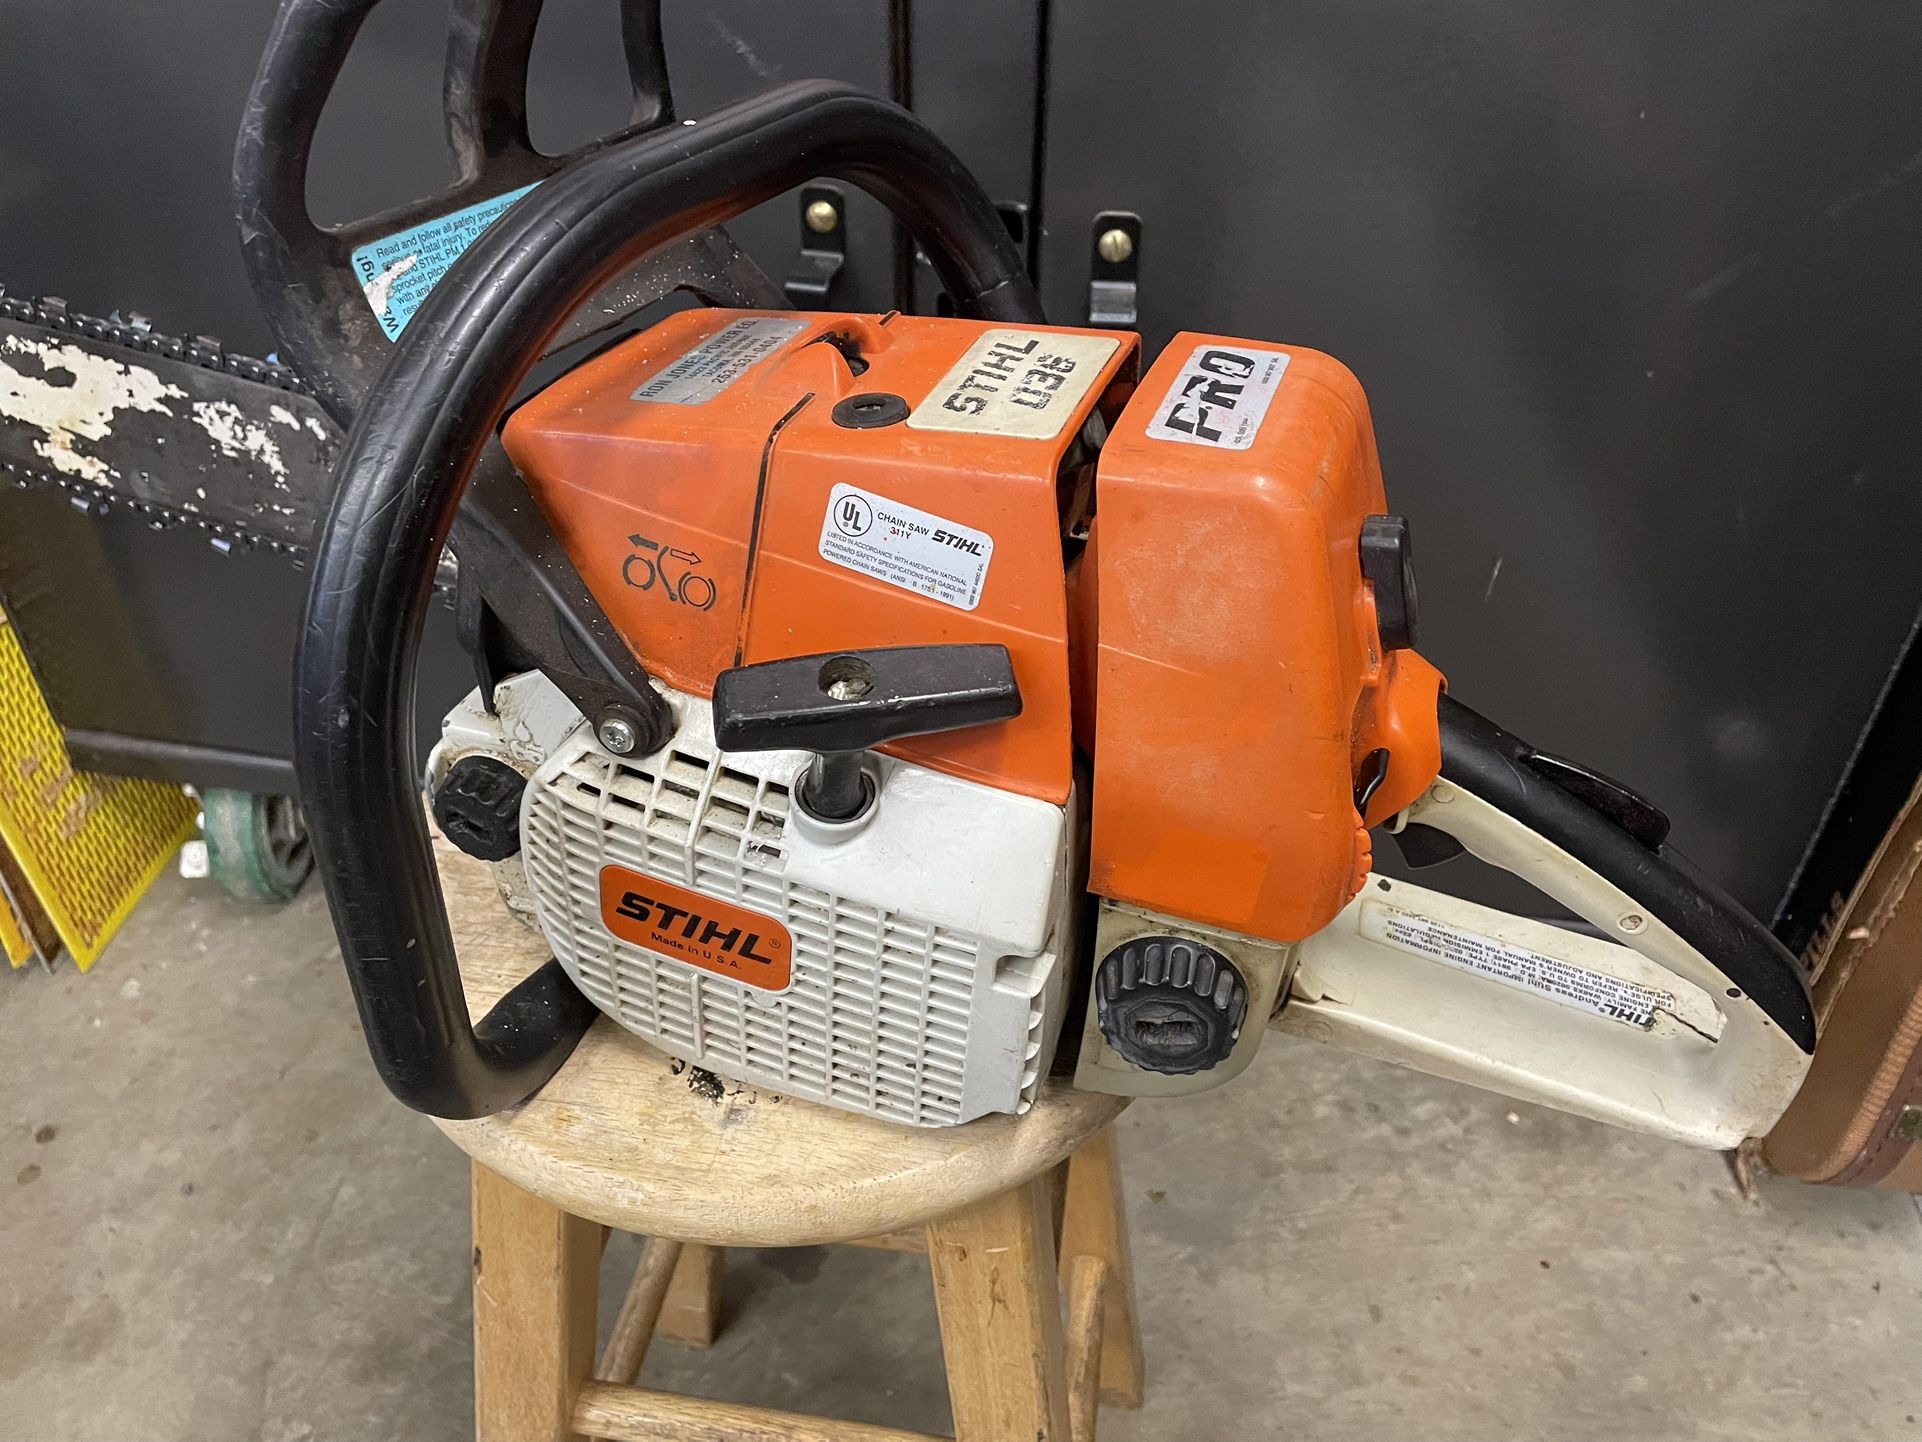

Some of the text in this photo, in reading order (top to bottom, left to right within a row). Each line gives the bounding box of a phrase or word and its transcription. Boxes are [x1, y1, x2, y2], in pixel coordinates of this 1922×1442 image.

[375, 241, 400, 258] Read
[399, 235, 418, 249] and
[416, 225, 441, 243] follow
[440, 221, 453, 234] all
[450, 212, 478, 232] safety
[421, 238, 442, 254] fatal
[440, 230, 466, 249] injury.
[465, 225, 477, 237] To
[417, 251, 445, 268] STIHL
[444, 245, 460, 258] PM
[390, 263, 448, 295] sprocket pitch
[395, 284, 431, 305] with any
[638, 379, 673, 397] RON
[697, 329, 743, 354] POWER
[942, 339, 1039, 416] STIHL
[1009, 353, 1077, 410] 036
[1164, 350, 1255, 442] PRO
[877, 511, 984, 557] CHAIN SAW STIHL
[889, 526, 911, 540] 311Y
[822, 548, 851, 563] POWERED
[851, 559, 869, 570] CHAIN
[870, 566, 886, 576] SAWS
[824, 539, 966, 595] STANDARD SAFETY SPECIFICATIONS FOR GASOLINE
[853, 541, 893, 559] ACCORDANCE
[893, 555, 908, 565] WITH
[908, 560, 938, 575] AMERICAN
[939, 571, 967, 586] NATIONAL
[616, 891, 772, 965] STIHL
[1427, 925, 1482, 947] MAINTENANCE
[651, 932, 684, 950] Made
[688, 944, 699, 956] in
[1385, 932, 1441, 955] INFORMATION
[1484, 944, 1500, 953] FOR
[1443, 951, 1473, 966] ENGINE
[1492, 954, 1518, 966] PHASE
[1502, 950, 1536, 965] MANUAL
[1520, 962, 1536, 971] EPA
[1476, 962, 1524, 982] IMPORTANT
[1556, 974, 1568, 982] TO
[1578, 974, 1588, 982] TO
[1585, 971, 1602, 980] AND
[1553, 986, 1599, 1007] Andreas
[1570, 979, 1616, 998] CONFORMS
[1618, 994, 1648, 1008] ENGINE
[1602, 1002, 1653, 1028] TIHL
